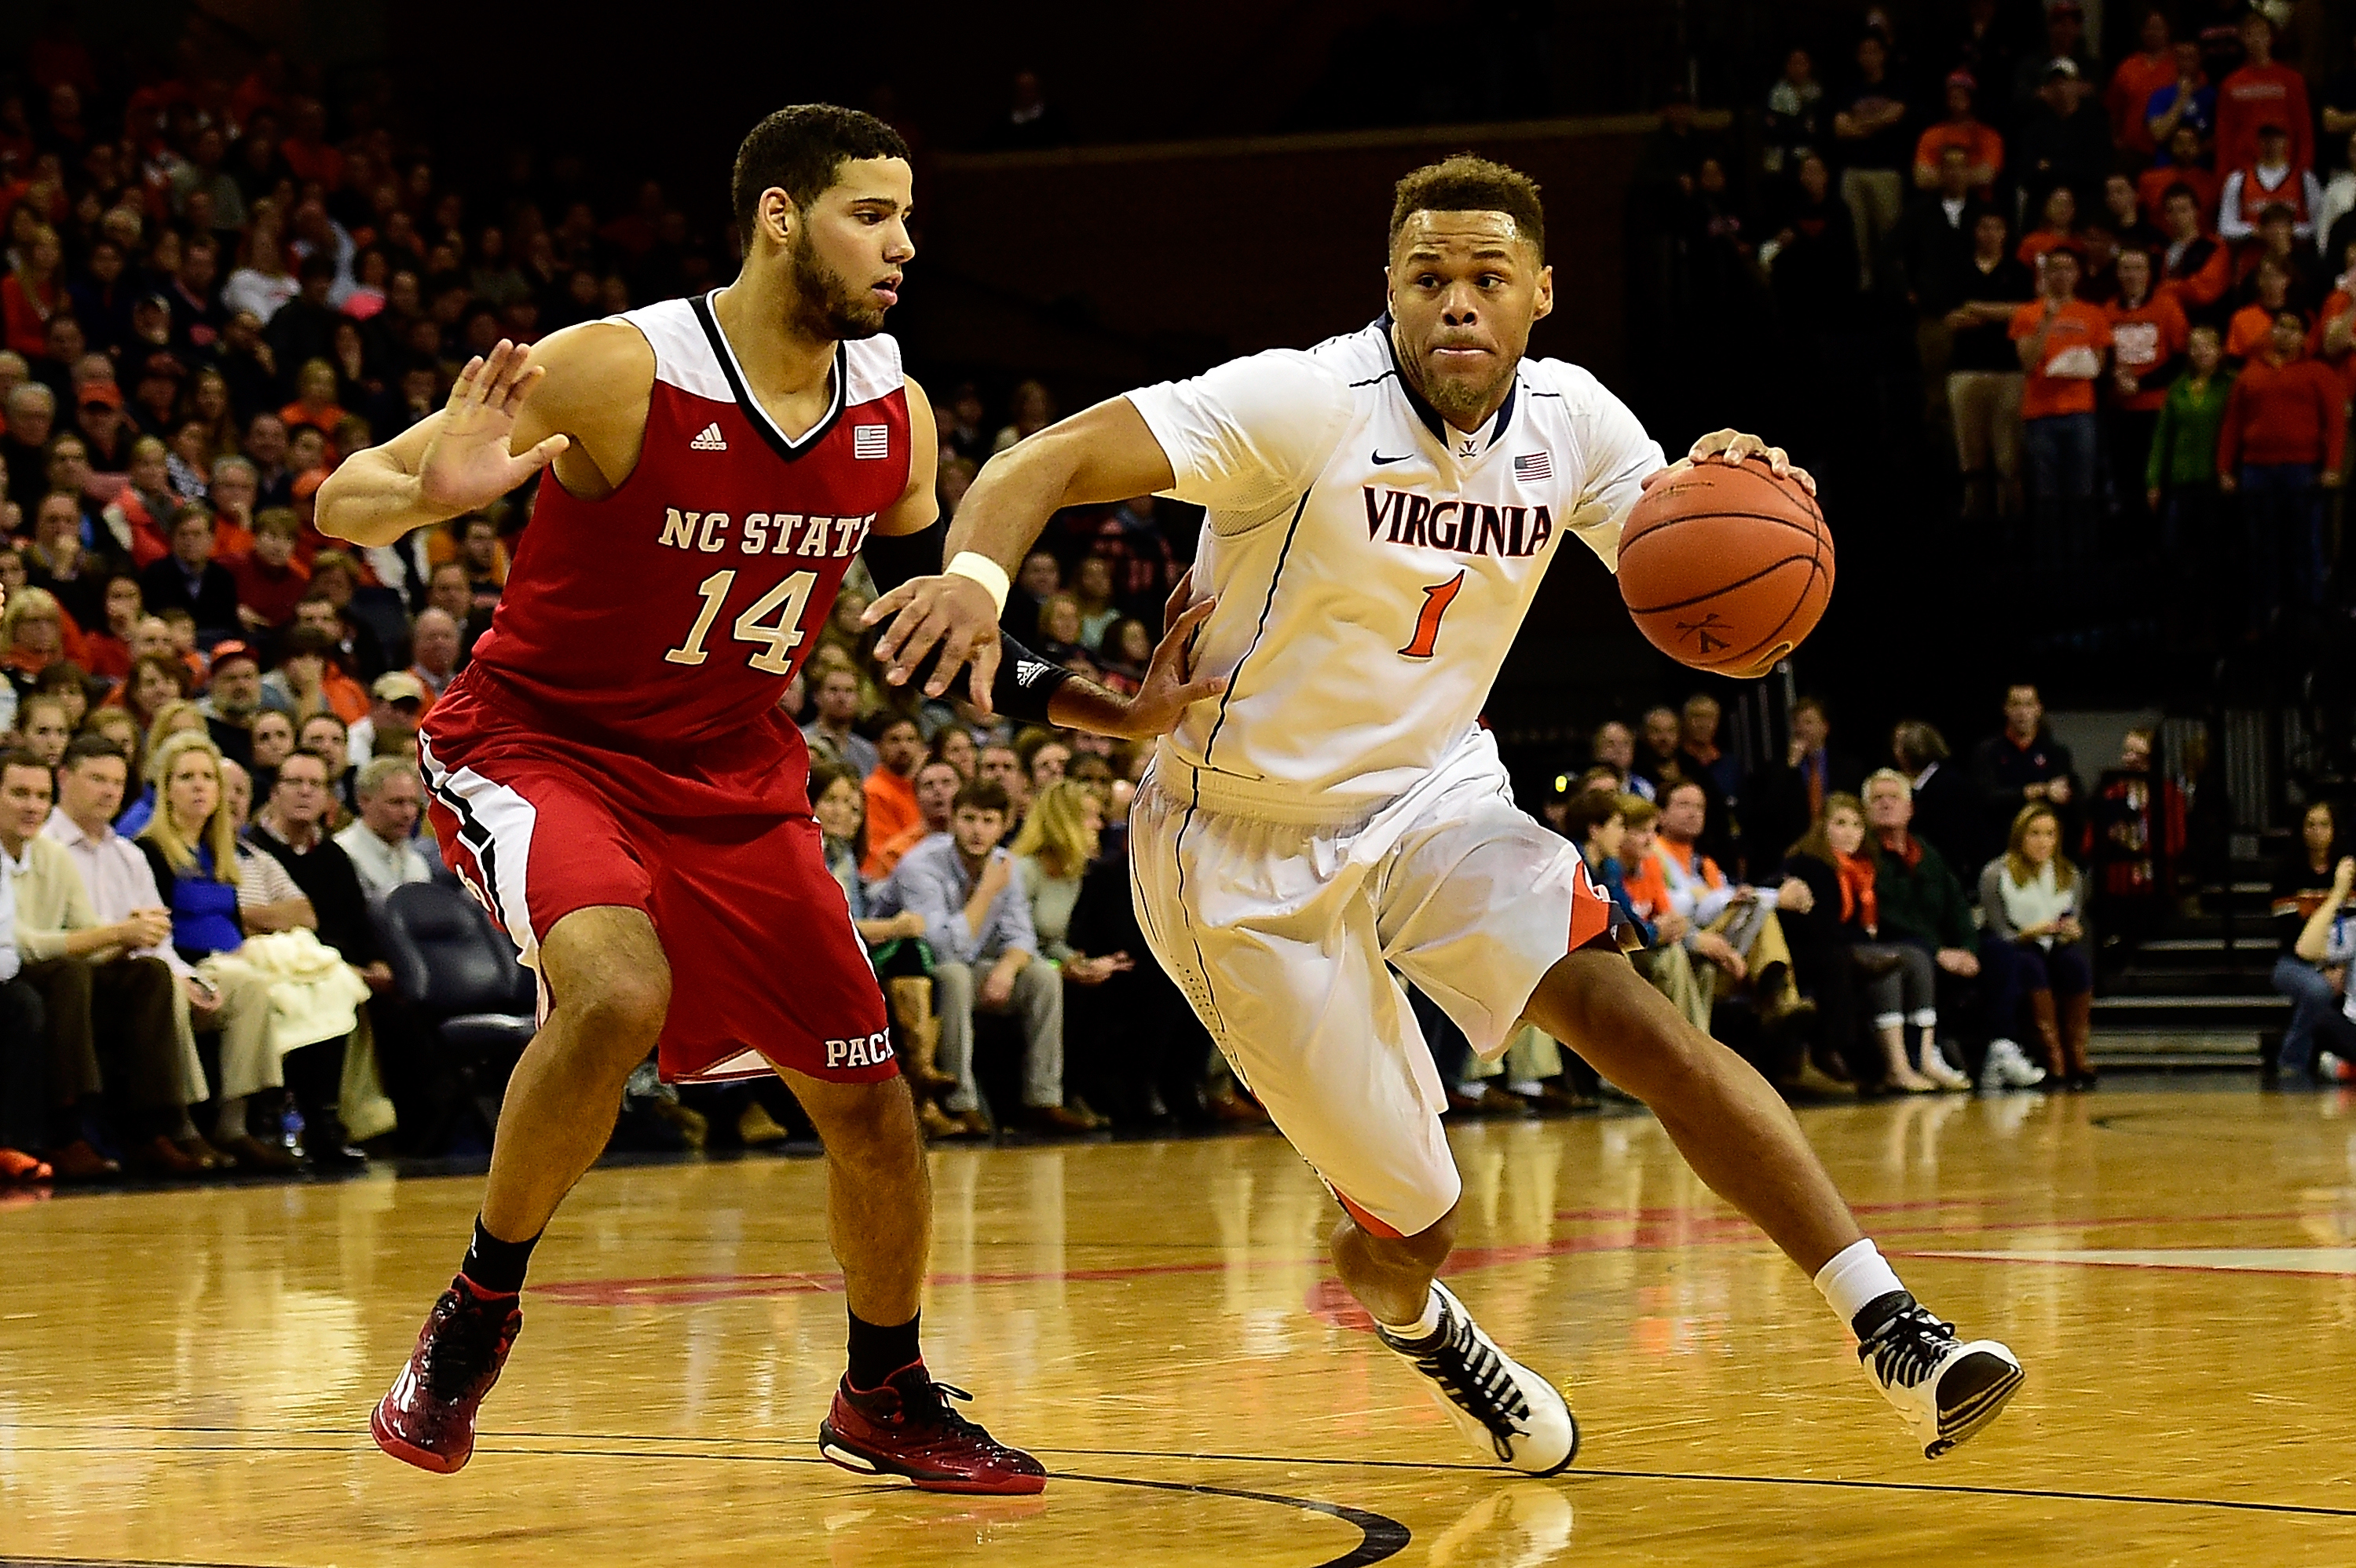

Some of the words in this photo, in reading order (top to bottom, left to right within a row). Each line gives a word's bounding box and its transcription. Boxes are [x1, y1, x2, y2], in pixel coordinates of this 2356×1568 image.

[690, 440, 727, 451] adidas
[658, 507, 730, 552] NC
[1362, 484, 1553, 558] VIRGINIA
[665, 569, 818, 675] 14
[1396, 568, 1466, 658] 1
